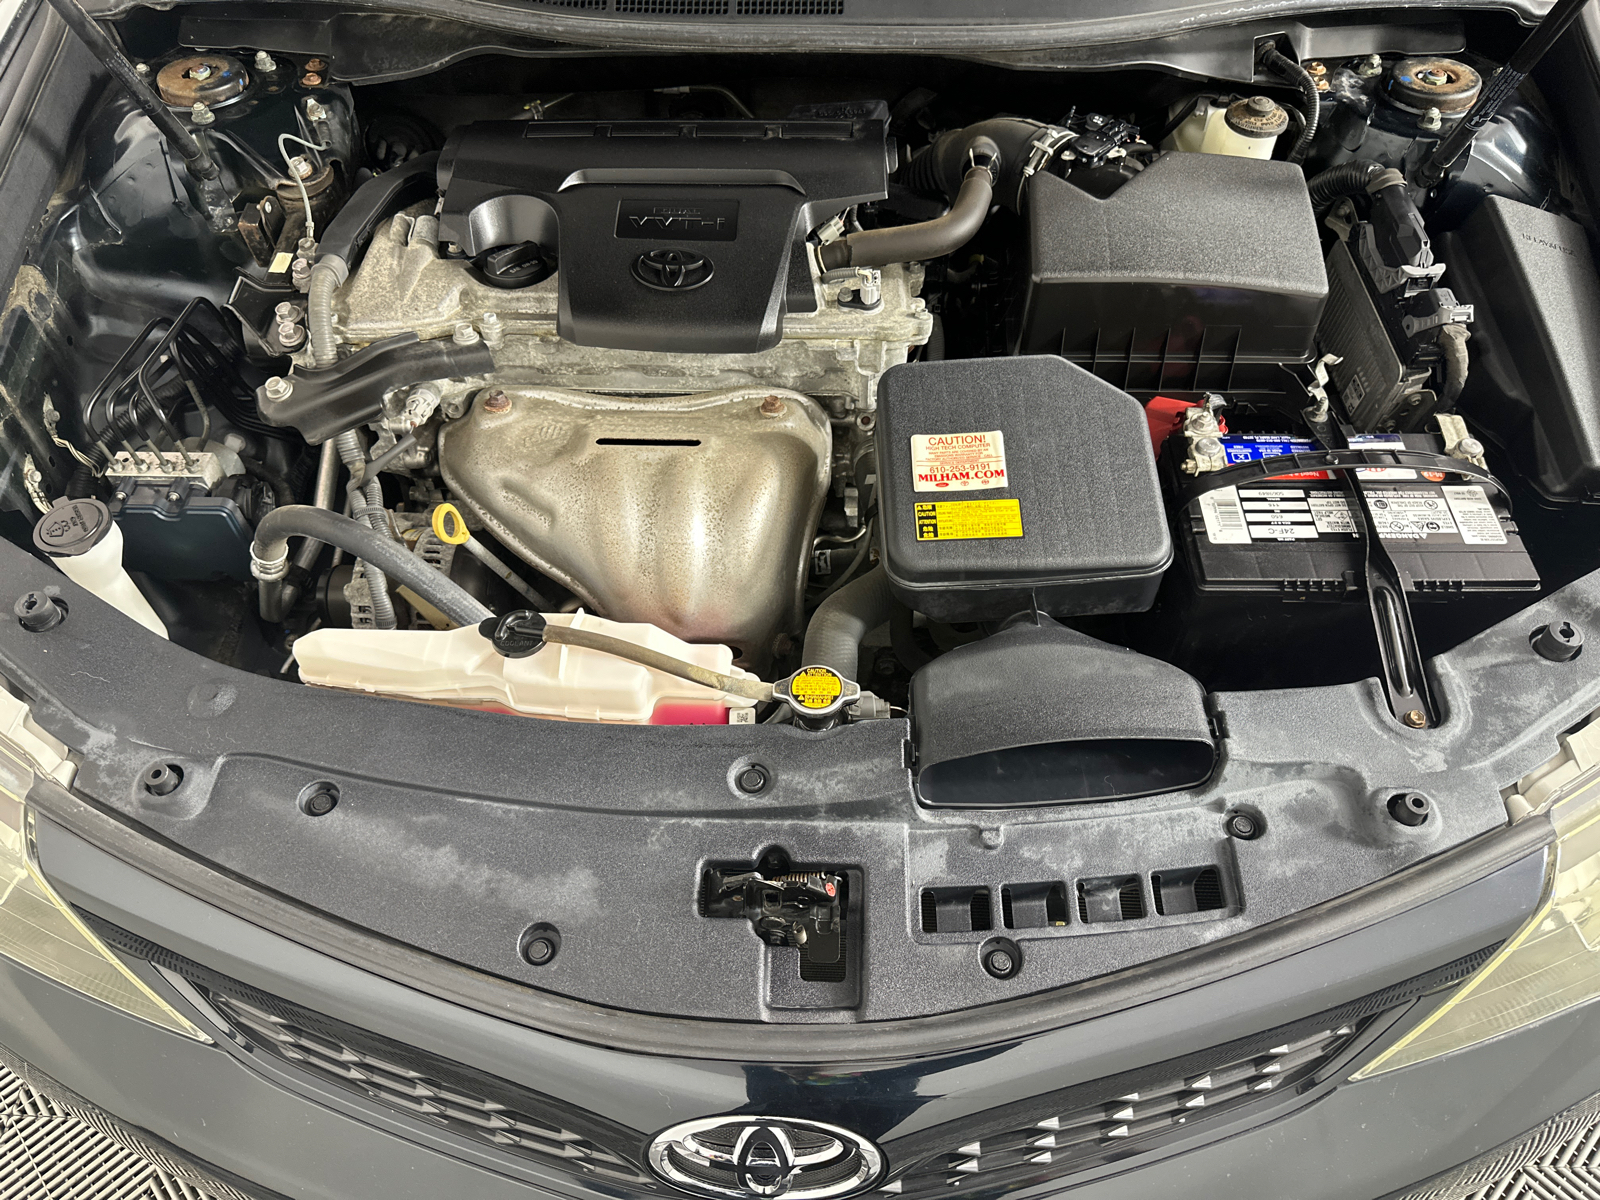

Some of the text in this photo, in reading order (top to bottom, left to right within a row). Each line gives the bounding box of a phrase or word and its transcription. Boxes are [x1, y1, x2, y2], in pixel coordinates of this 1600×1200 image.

[928, 434, 986, 446] CAUTION!
[929, 463, 991, 474] 610-253-9191
[918, 469, 1005, 482] MILHAM.COM
[1267, 527, 1295, 535] 24F-C
